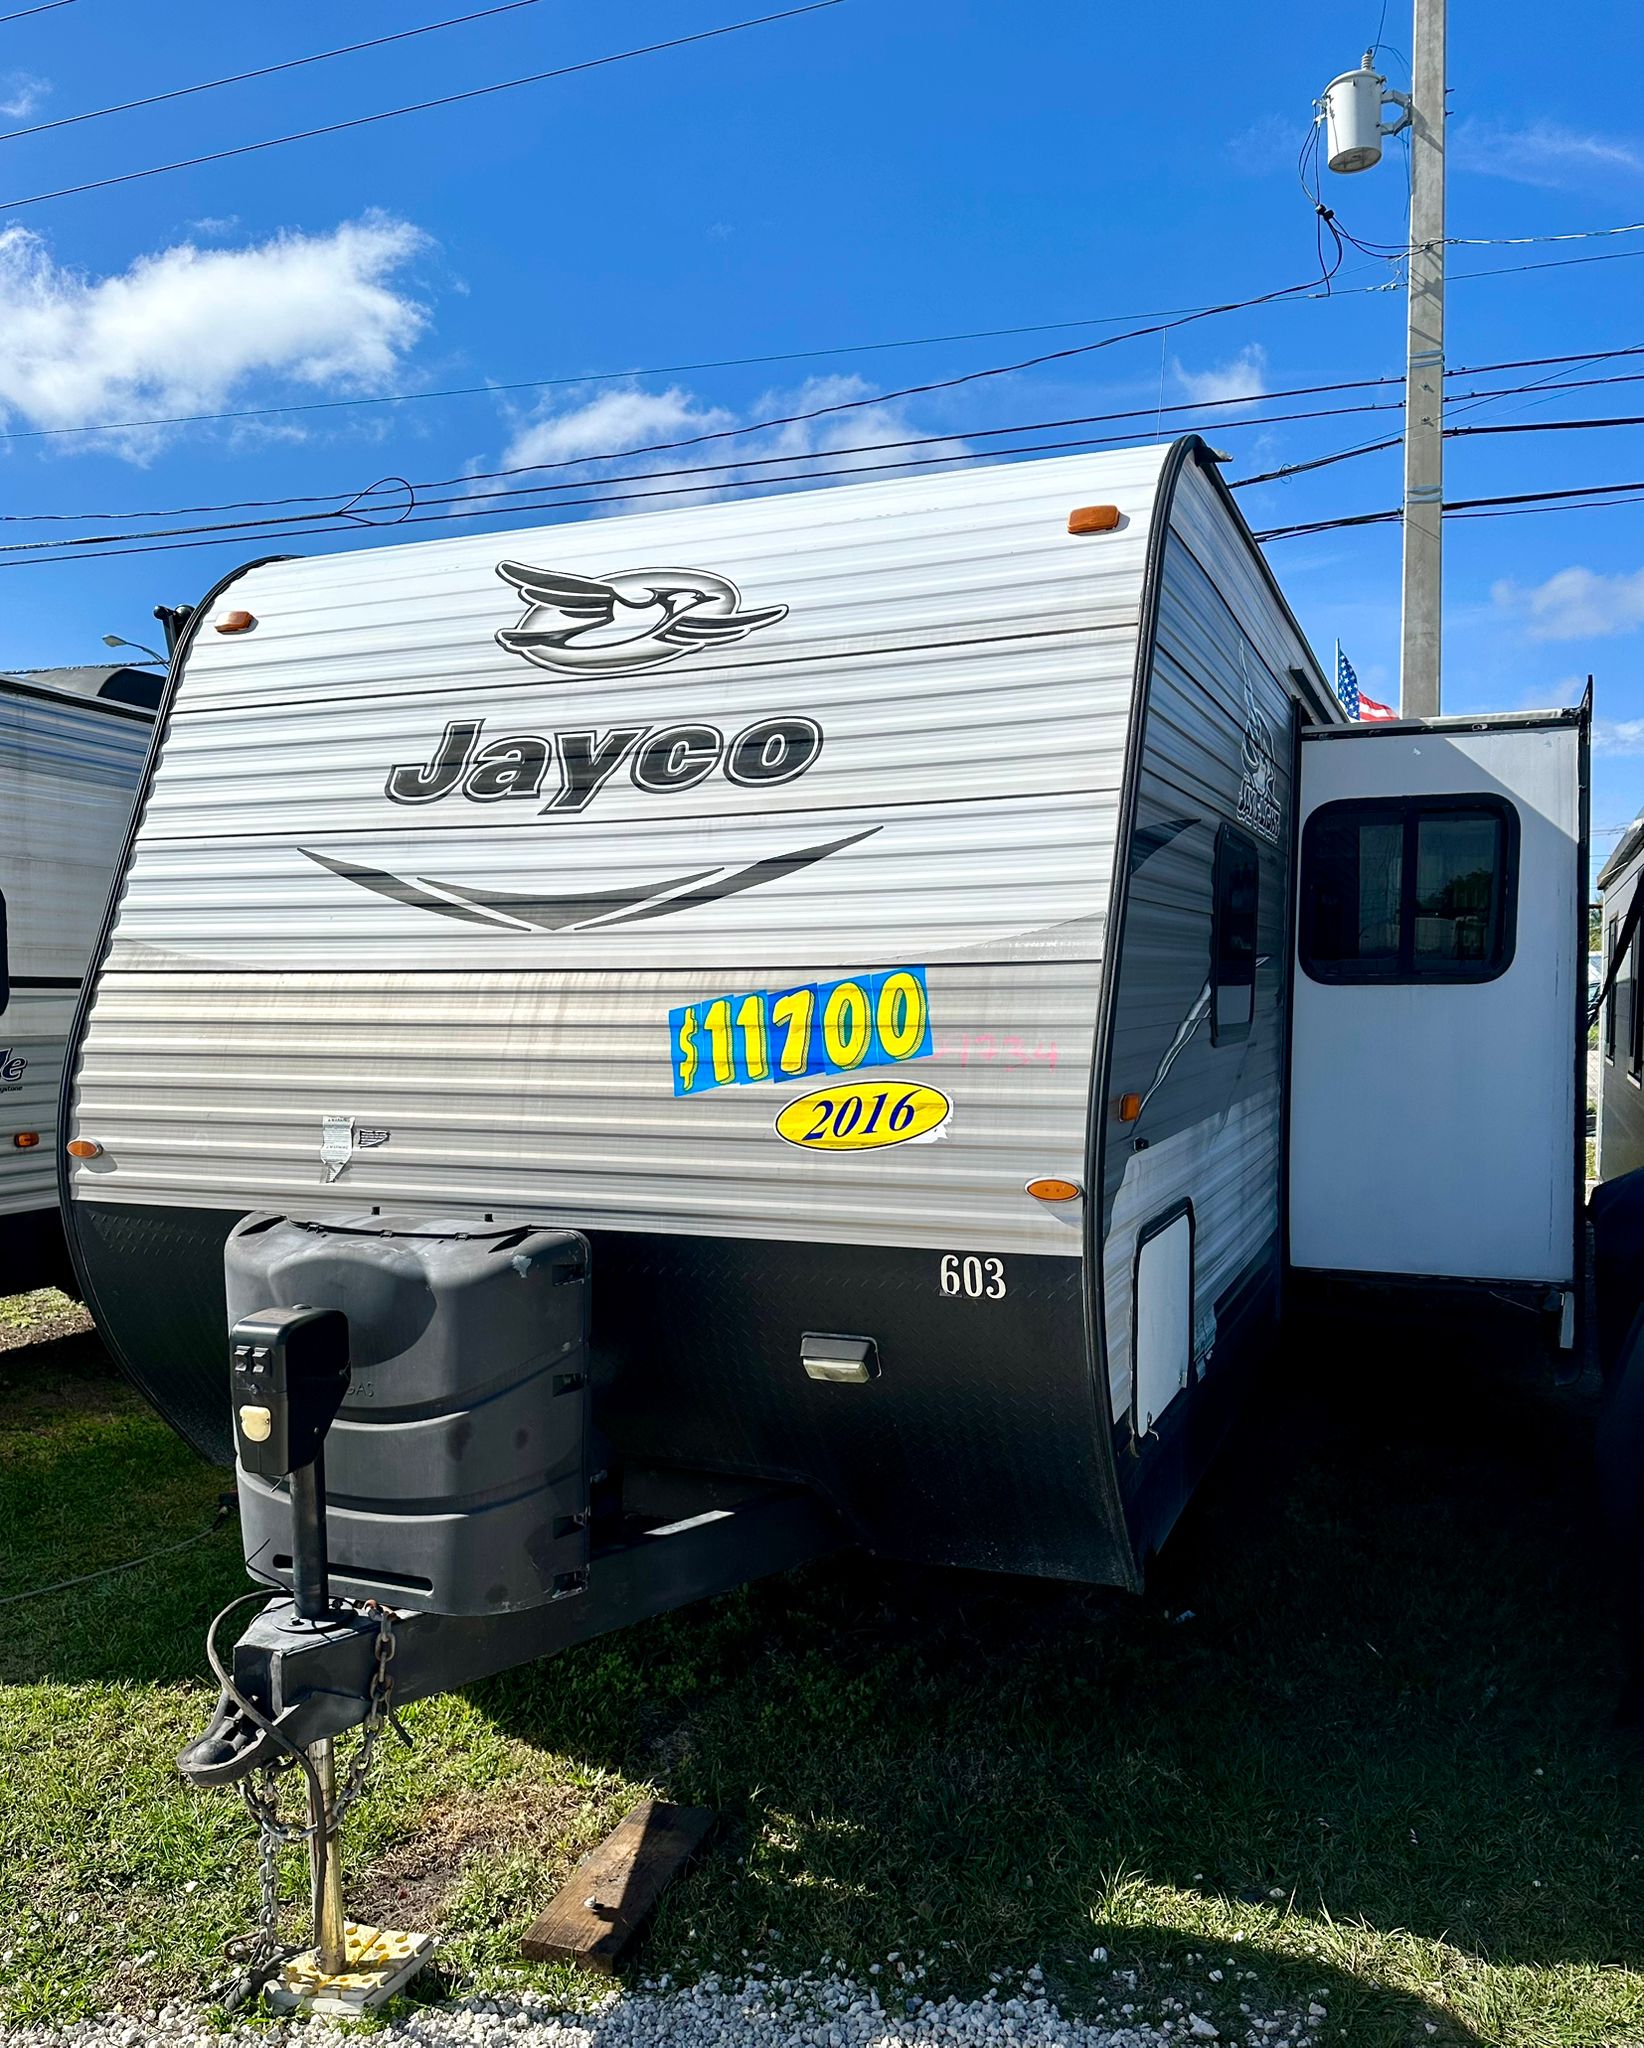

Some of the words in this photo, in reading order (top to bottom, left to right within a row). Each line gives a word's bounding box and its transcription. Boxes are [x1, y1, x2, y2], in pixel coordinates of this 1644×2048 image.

[384, 716, 824, 815] Jayco
[678, 971, 927, 1091] $11700
[802, 1089, 922, 1142] 2016
[941, 1254, 1007, 1300] 603
